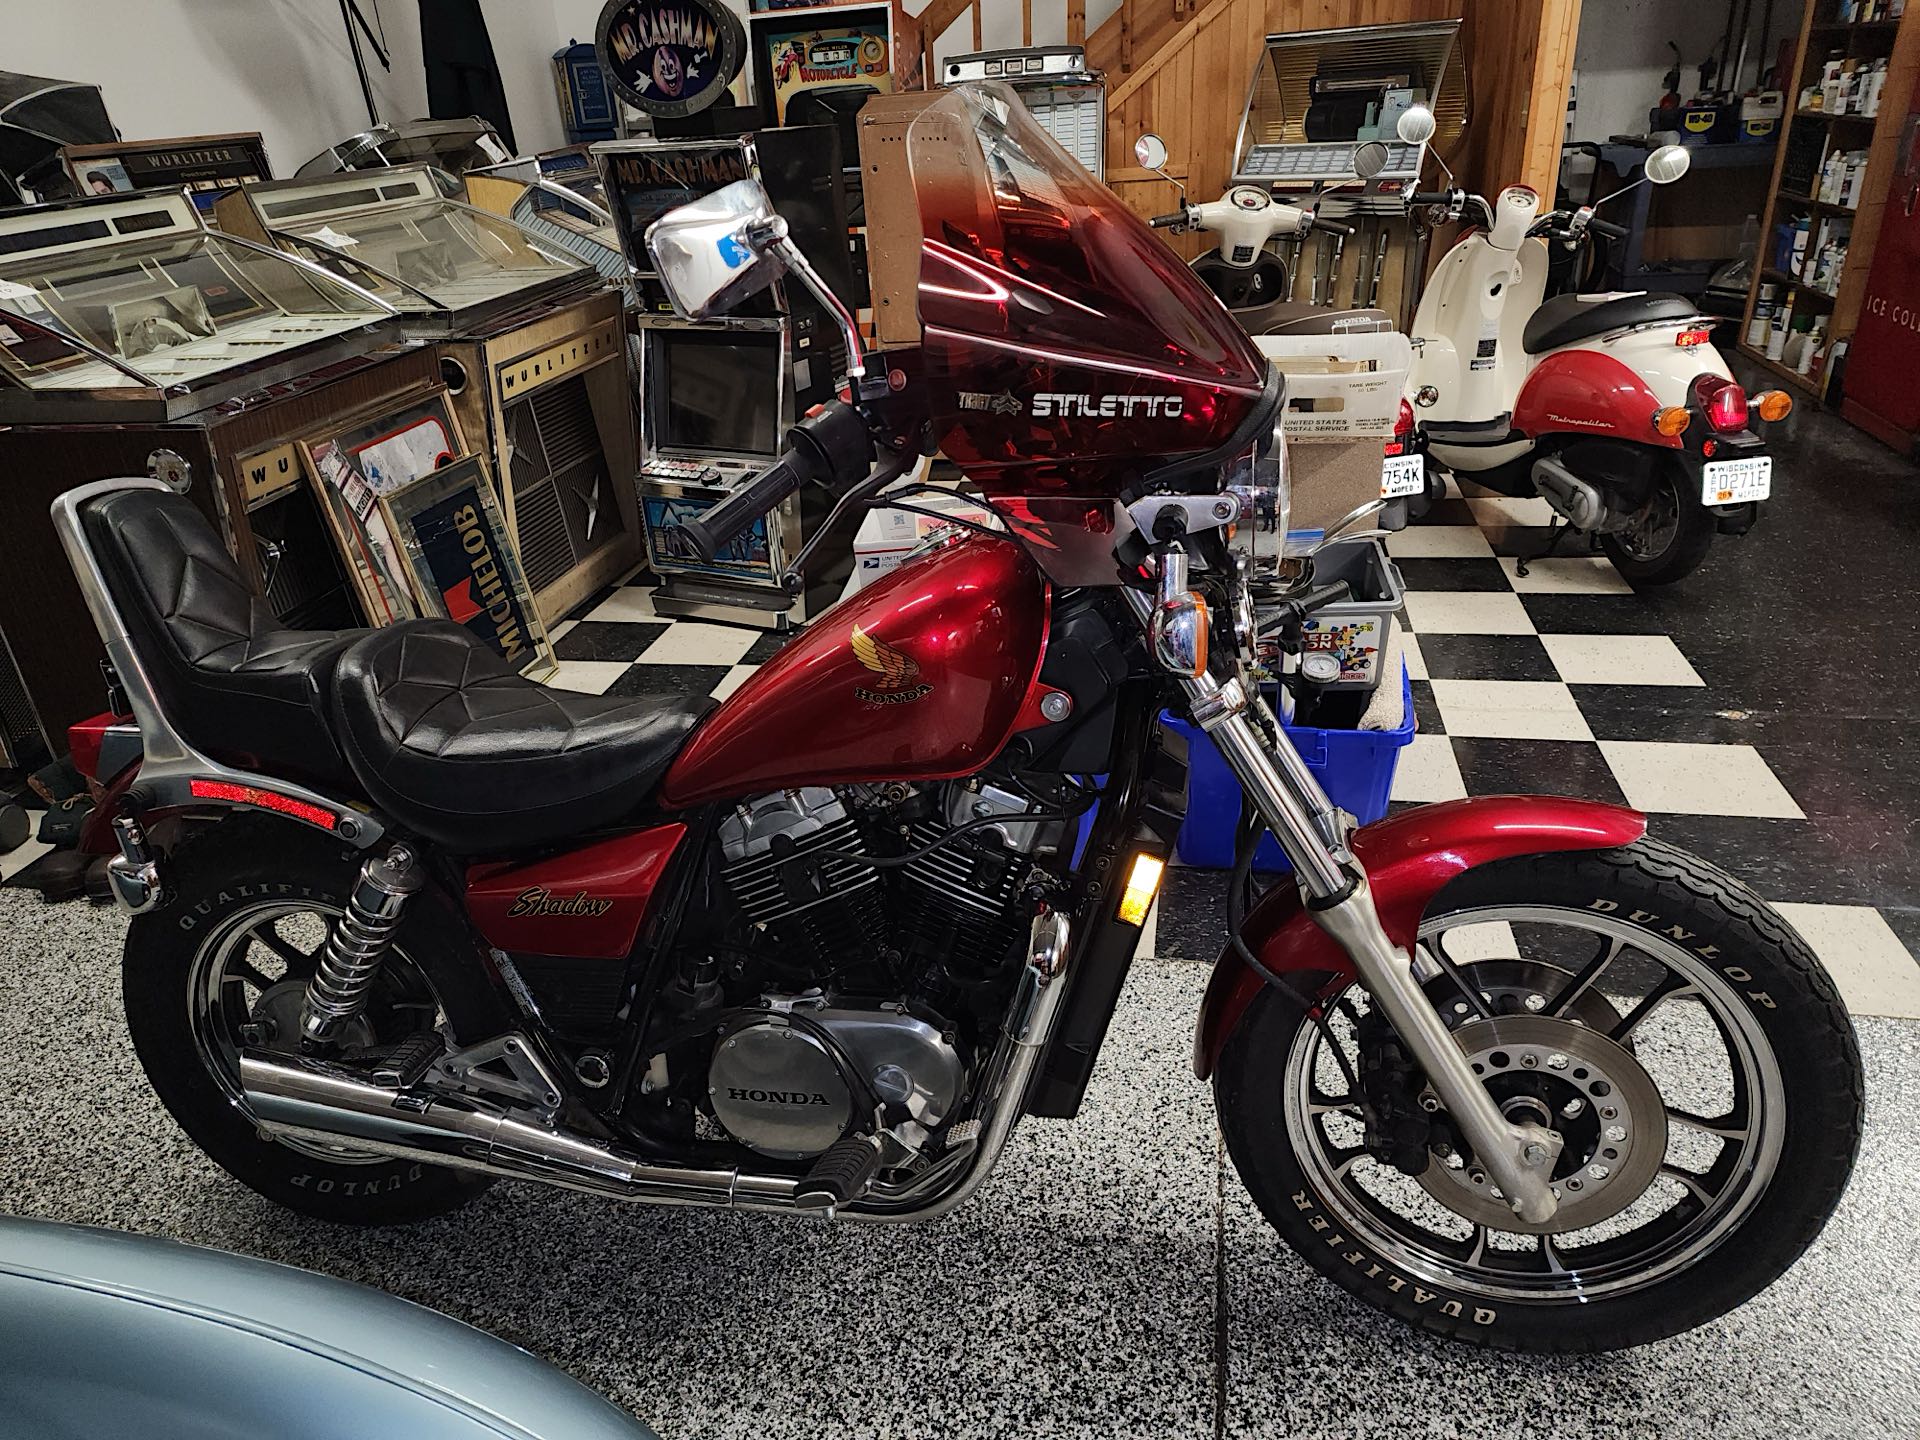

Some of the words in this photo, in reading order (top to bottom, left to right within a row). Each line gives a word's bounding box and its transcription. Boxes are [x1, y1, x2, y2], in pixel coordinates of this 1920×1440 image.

[609, 23, 643, 65] MR.
[639, 8, 719, 60] CASHMAN
[801, 64, 857, 83] MOTORCYCLE
[1688, 114, 1714, 123] WD-40
[147, 150, 232, 168] WURLITZER
[616, 158, 650, 184] MR.
[650, 154, 746, 184] CASHMAN
[1866, 295, 1887, 316] ICE
[505, 333, 611, 389] WURLITZER
[1032, 393, 1183, 417] STILETTO
[1546, 413, 1615, 428] Metropolitan
[1384, 460, 1413, 469] CONSIN
[1717, 462, 1762, 472] WISCONSIN
[1383, 467, 1420, 485] 754K
[1719, 470, 1766, 490] D271E
[1391, 484, 1414, 493] MOPED
[356, 489, 373, 516] LIGHT
[454, 503, 527, 664] MICHELOB
[1308, 633, 1332, 641] ED
[855, 684, 935, 705] HONDA
[179, 883, 337, 931] QUALIFIE
[507, 885, 613, 918] Shadow
[1587, 898, 1777, 1009] DUNLOP
[727, 1087, 832, 1106] HONDA
[290, 1163, 425, 1196] DUNLOP
[1291, 1189, 1497, 1326] QUALIFIER
